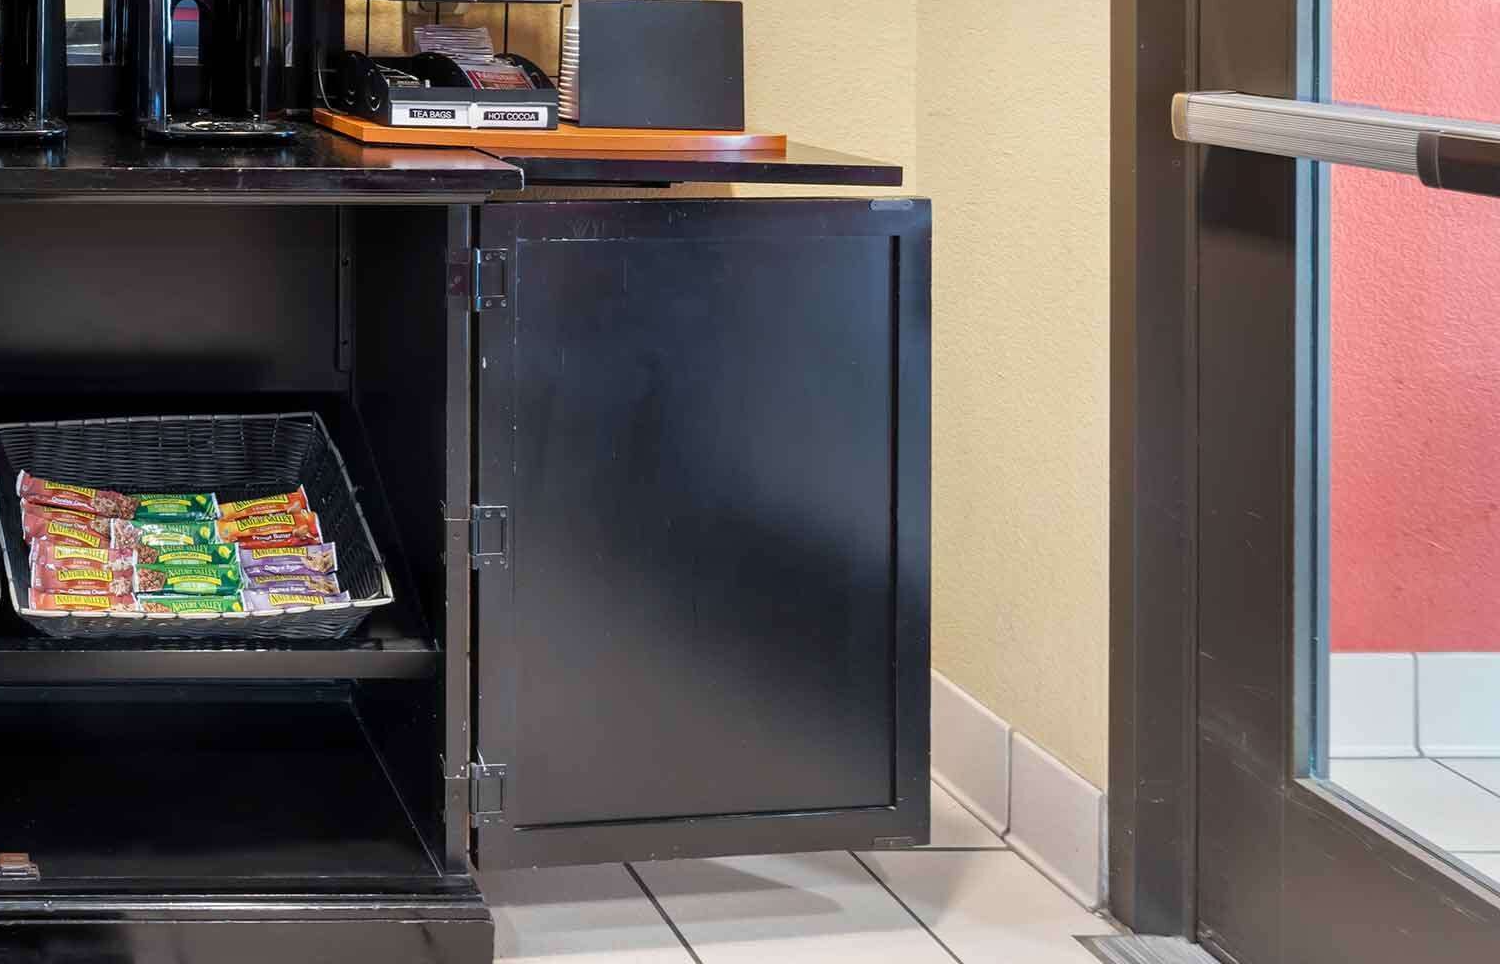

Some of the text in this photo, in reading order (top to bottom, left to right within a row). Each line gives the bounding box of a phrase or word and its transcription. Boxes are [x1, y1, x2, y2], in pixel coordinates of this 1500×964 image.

[412, 110, 452, 119] TEA BAGS
[266, 514, 292, 524] VALLEY
[254, 547, 305, 558] NATURE VALLEY
[85, 570, 110, 580] VALLEY
[83, 596, 107, 605] VALLEY
[172, 601, 222, 612] NATURE VALLEY
